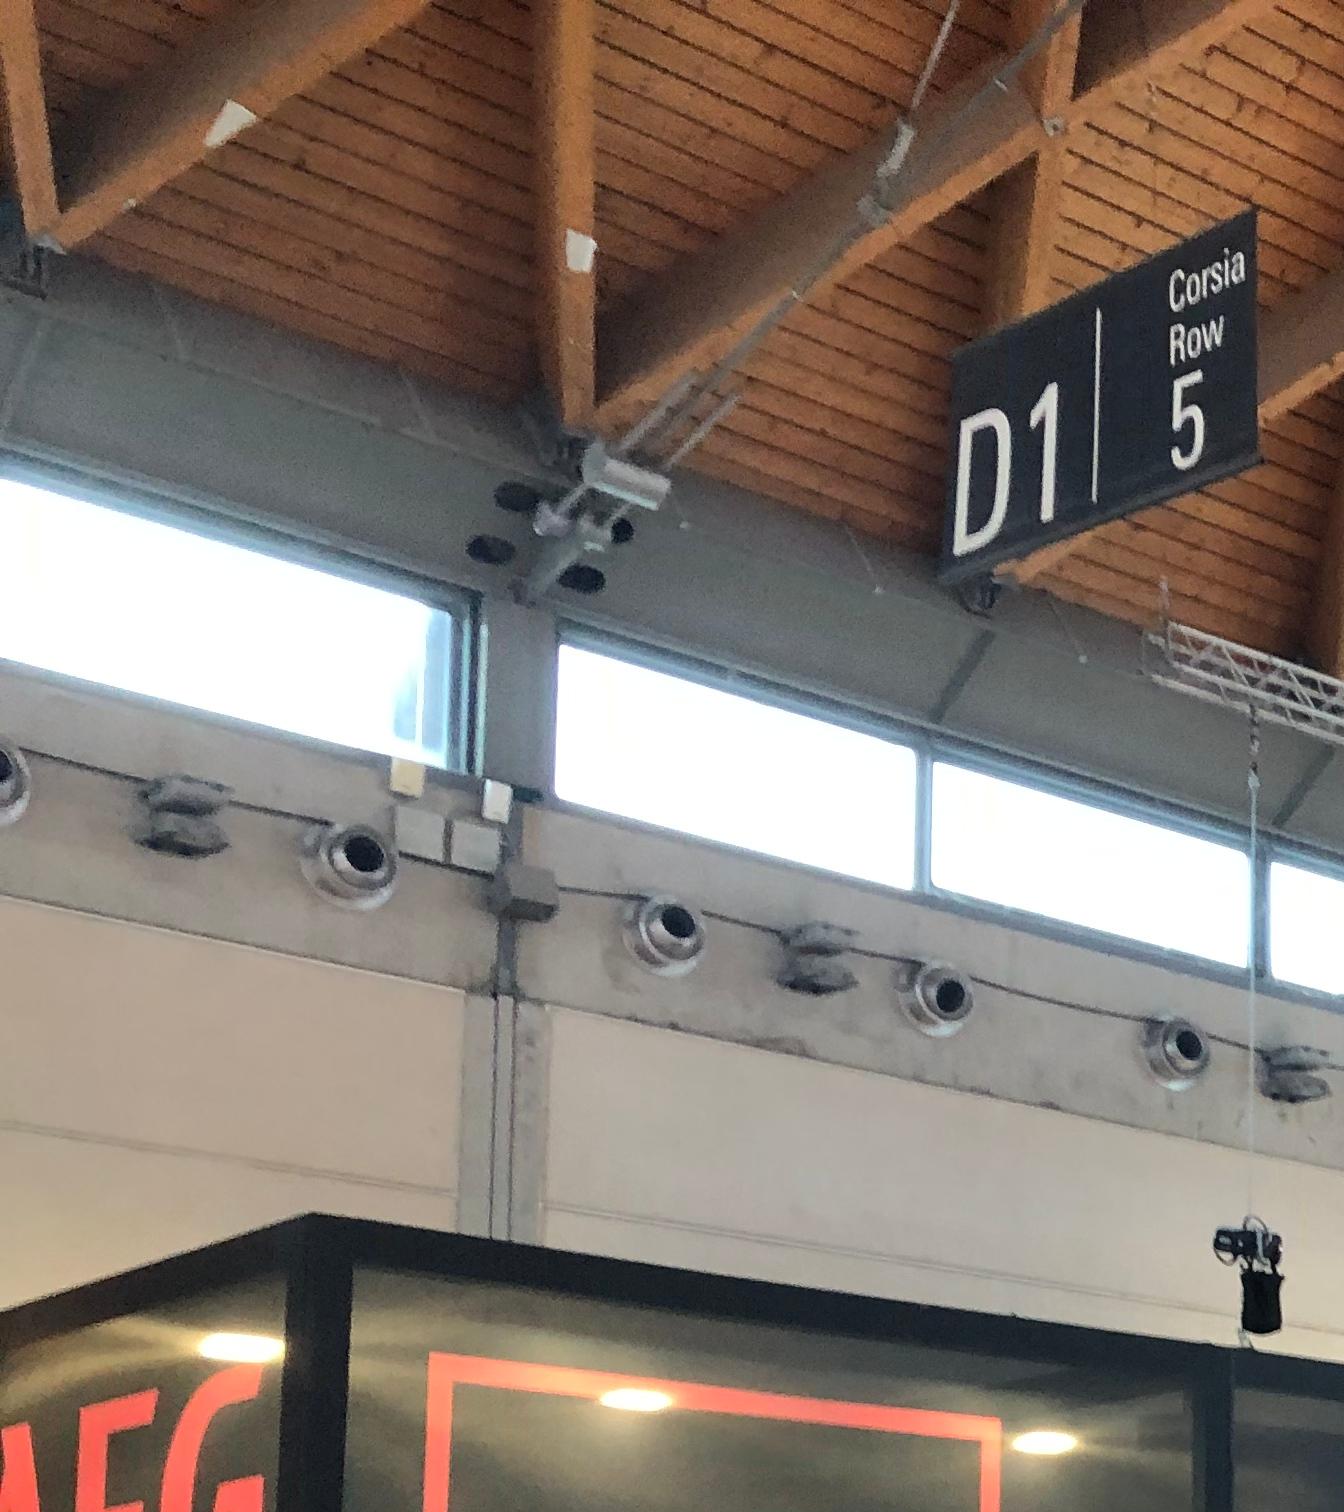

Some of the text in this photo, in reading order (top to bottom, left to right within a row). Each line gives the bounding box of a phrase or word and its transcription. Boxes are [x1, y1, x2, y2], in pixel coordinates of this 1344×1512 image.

[1168, 247, 1246, 313] Corsia
[1169, 315, 1226, 366] Row
[1170, 369, 1206, 471] 5
[952, 381, 1059, 557] D1
